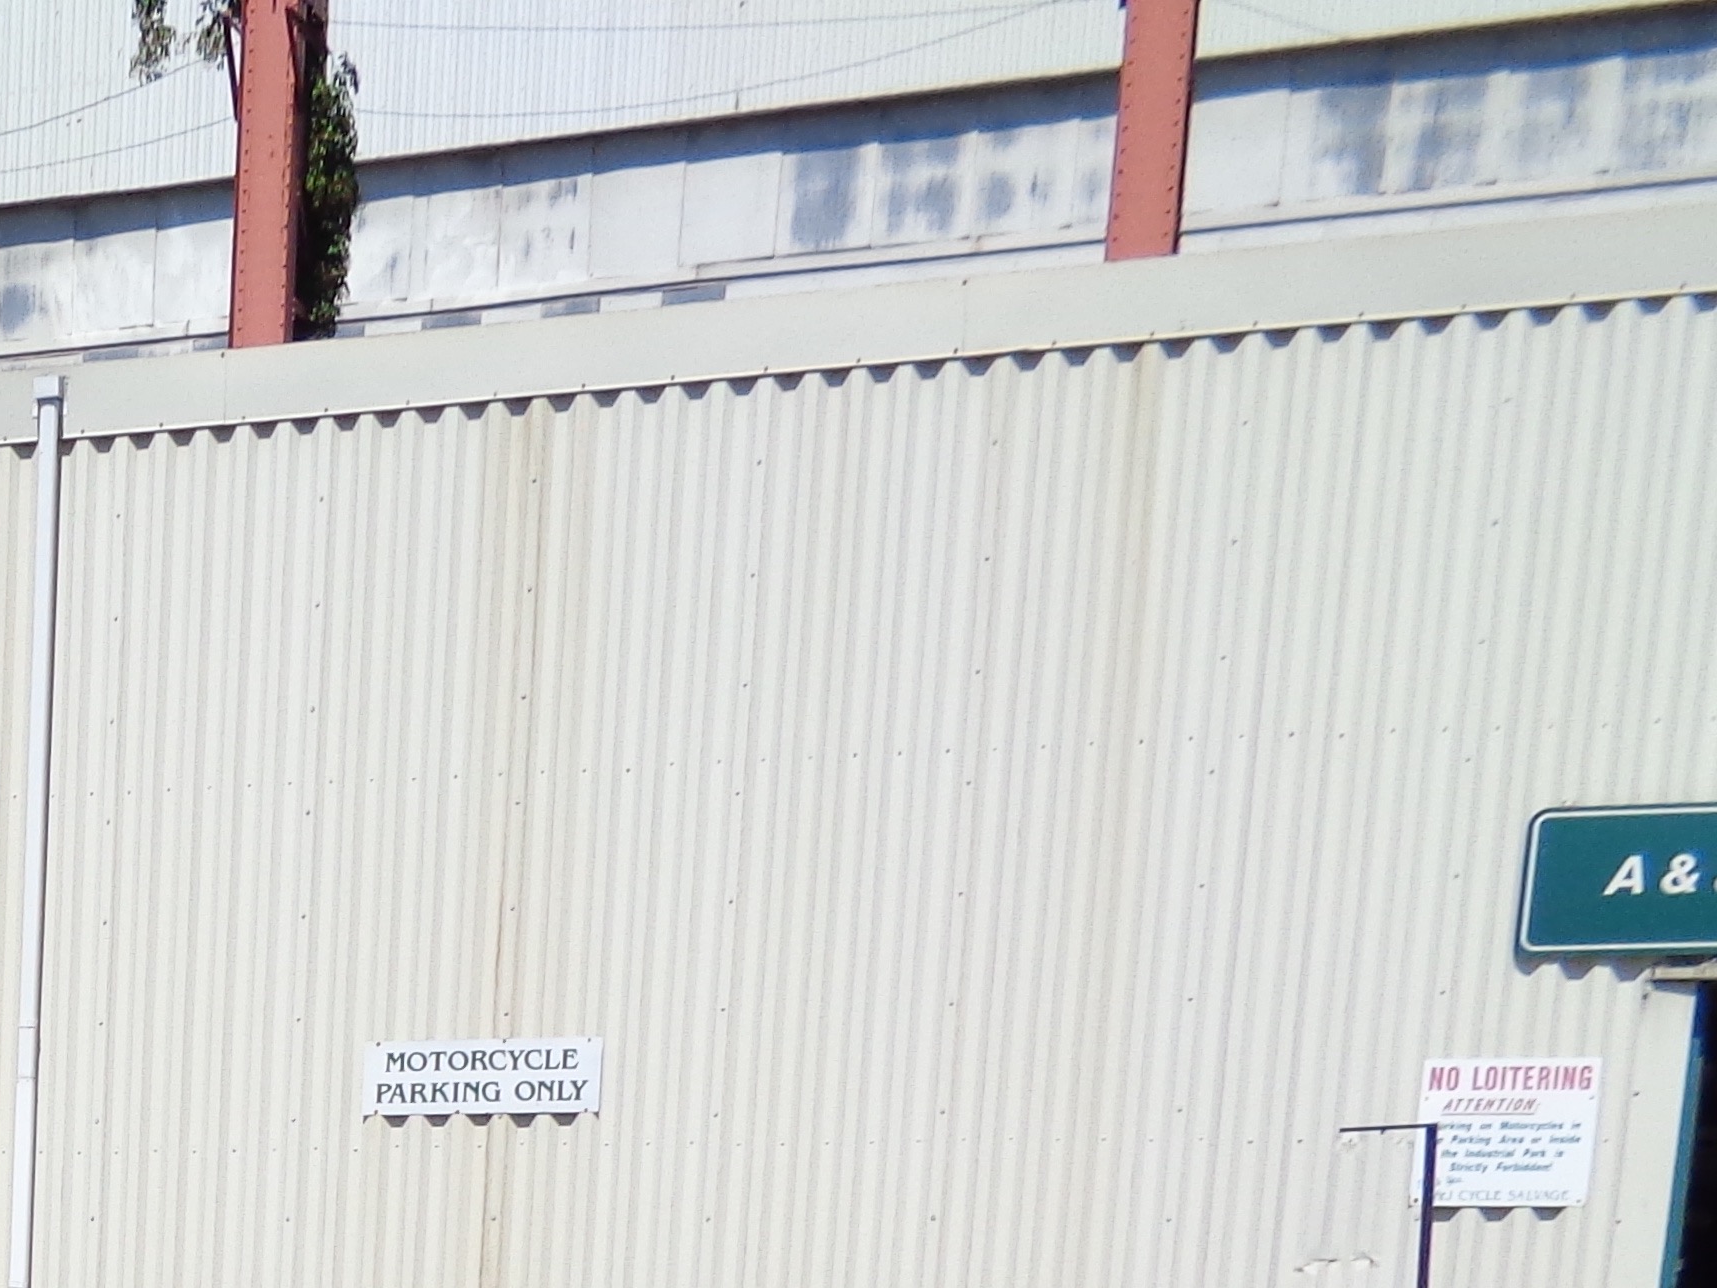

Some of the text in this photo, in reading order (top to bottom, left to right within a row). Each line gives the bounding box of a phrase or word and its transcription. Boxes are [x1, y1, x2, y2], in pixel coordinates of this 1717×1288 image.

[1602, 853, 1701, 896] A &
[385, 1049, 579, 1073] MOTORCYCLE
[1428, 1065, 1594, 1091] NO LOITERING
[376, 1080, 589, 1104] PARKING ONLY
[1451, 1135, 1492, 1146] Parking
[1458, 1190, 1501, 1201] CYCLE
[1508, 1190, 1571, 1201] SALVAGE
